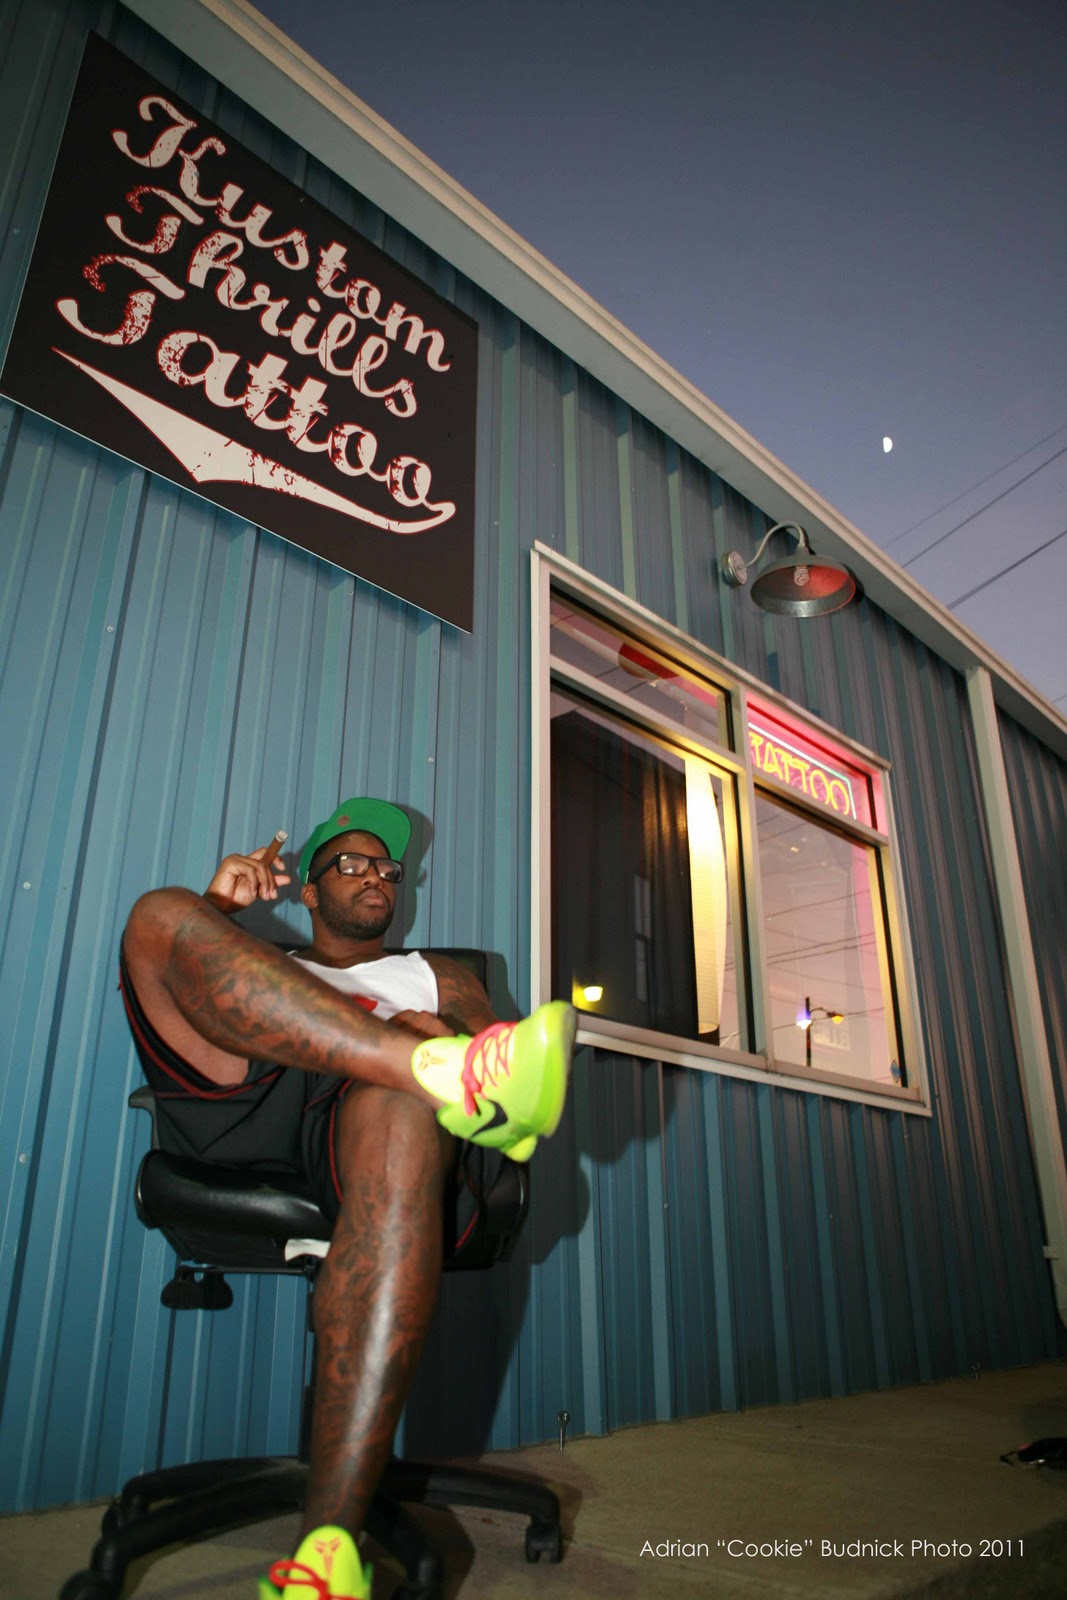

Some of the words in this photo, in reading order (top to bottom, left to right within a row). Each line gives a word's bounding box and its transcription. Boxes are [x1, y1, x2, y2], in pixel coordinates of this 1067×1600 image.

[105, 185, 418, 418] Thrills
[111, 95, 452, 373] Kustom
[56, 252, 434, 508] Tattoo
[748, 730, 850, 816] TATTOO
